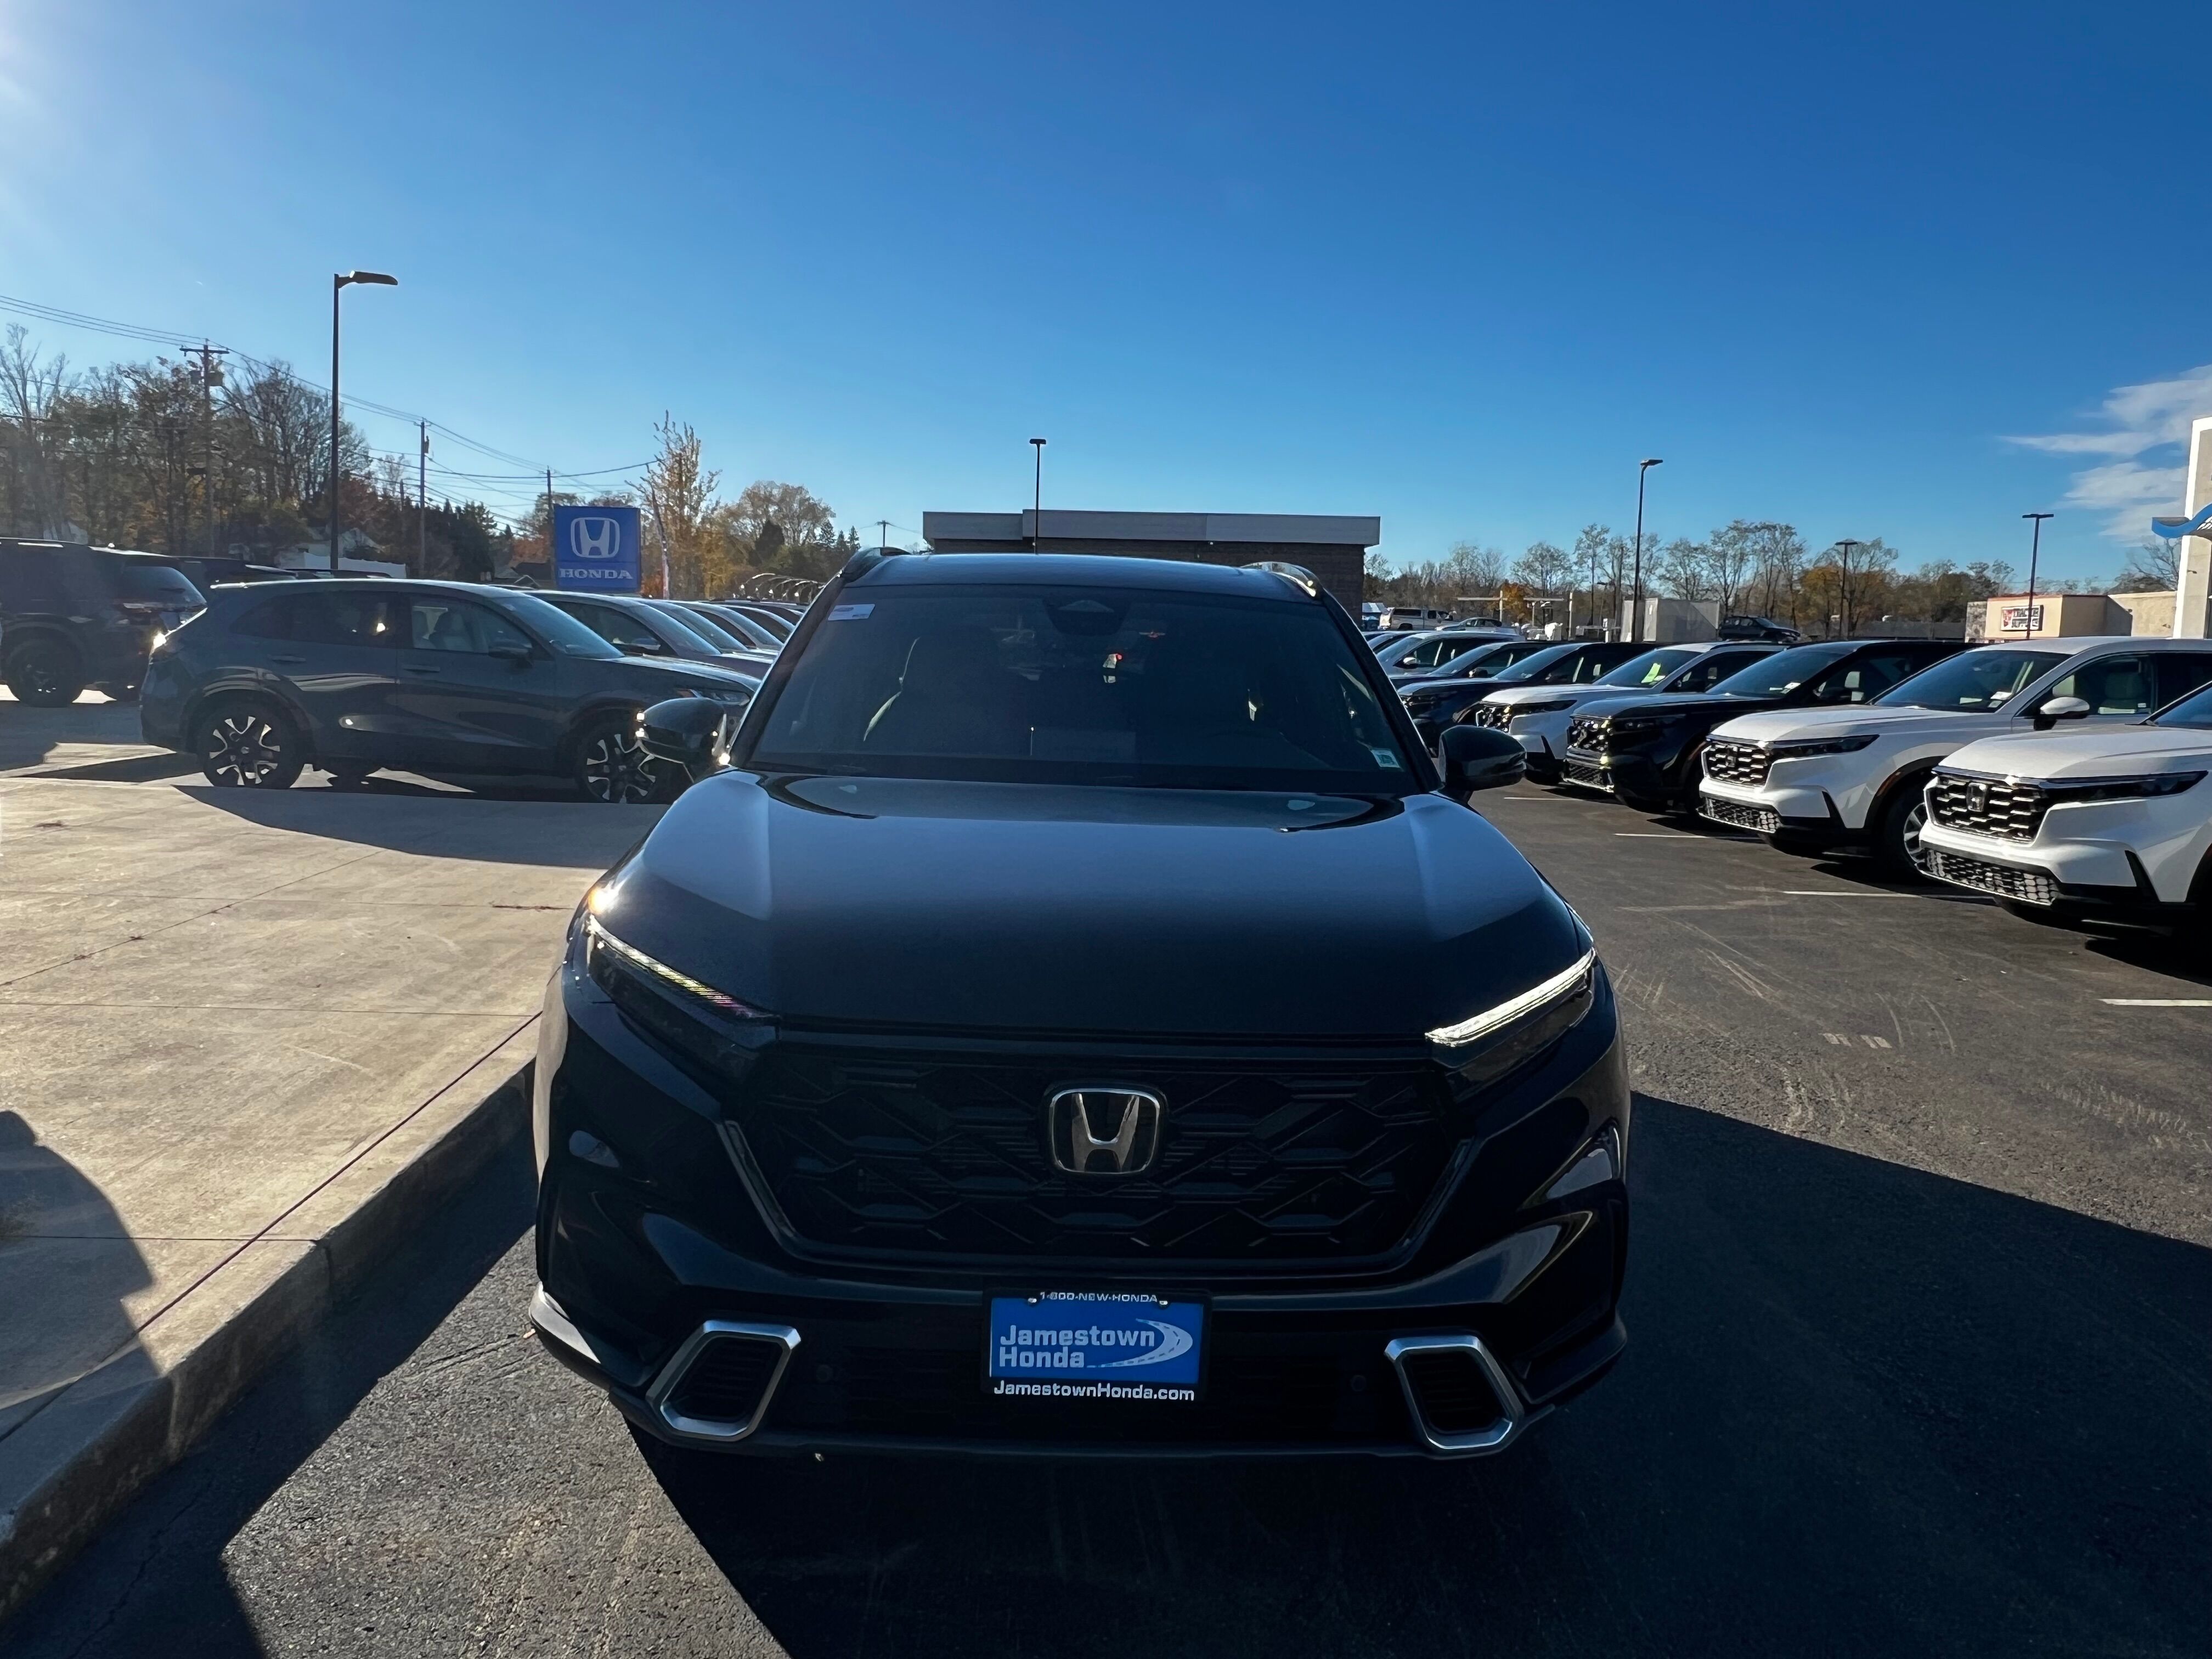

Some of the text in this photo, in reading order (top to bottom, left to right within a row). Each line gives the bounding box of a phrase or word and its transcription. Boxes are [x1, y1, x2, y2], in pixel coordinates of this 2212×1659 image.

[558, 568, 634, 580] HONDA
[1000, 1325, 1155, 1347] Jamestown
[998, 1346, 1085, 1368] Honda
[994, 1380, 1195, 1401] JamestownHonda.com
